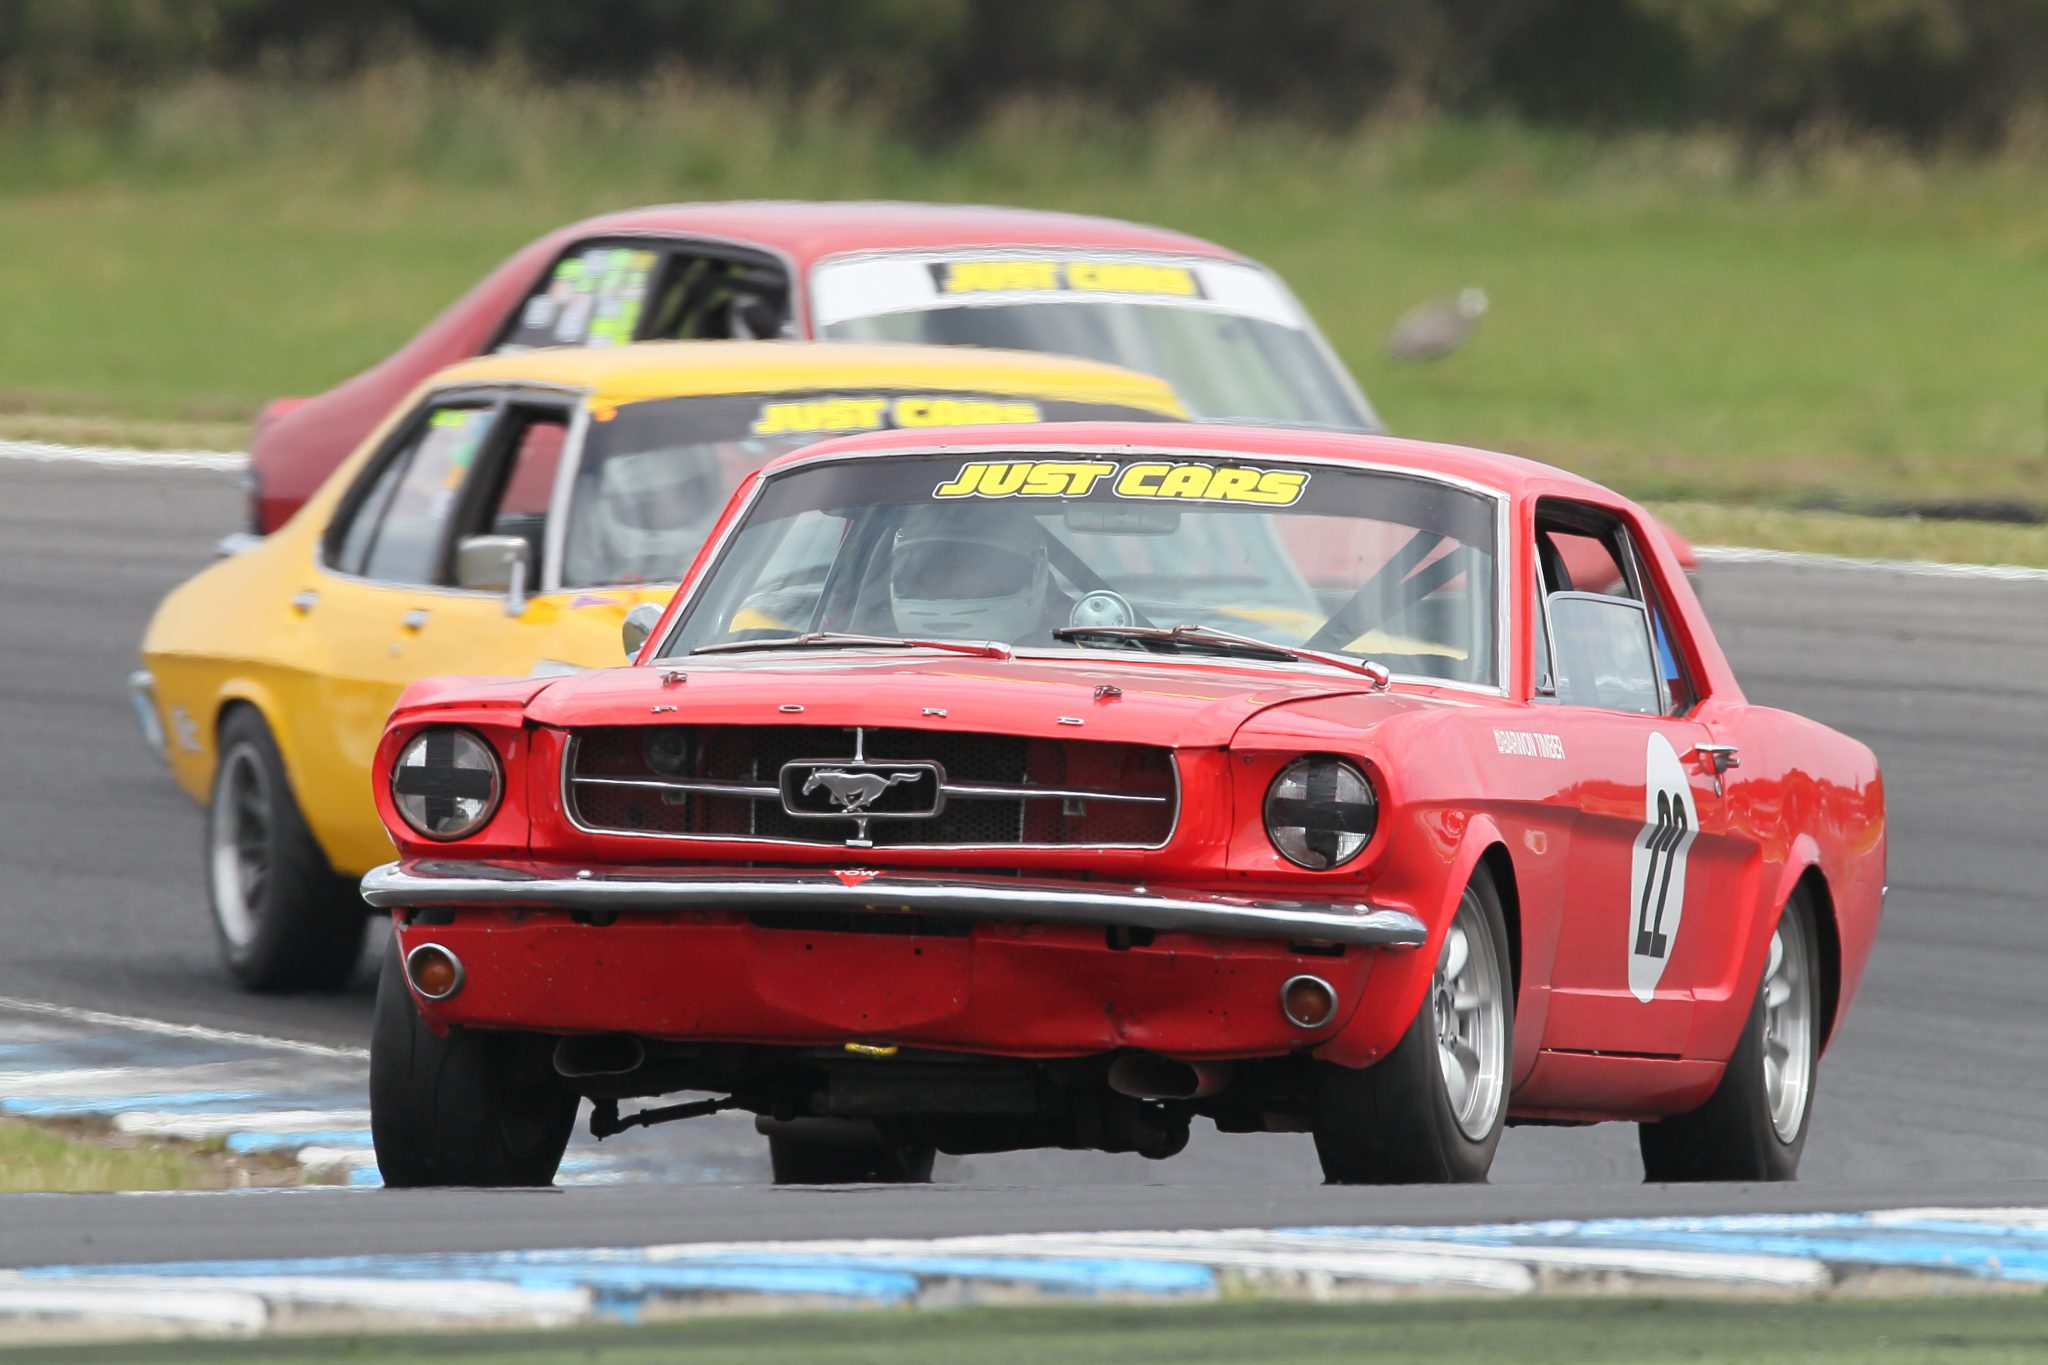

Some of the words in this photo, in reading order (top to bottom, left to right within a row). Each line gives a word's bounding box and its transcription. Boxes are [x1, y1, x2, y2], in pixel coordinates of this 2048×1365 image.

[944, 261, 1057, 292] JUST
[754, 398, 887, 435] JUST
[893, 398, 1041, 427] CARS
[935, 461, 1117, 498] JUST
[1114, 462, 1309, 506] CARS
[1533, 732, 1566, 760] TIMBER
[833, 869, 880, 877] TOW
[1634, 788, 1688, 959] 22
